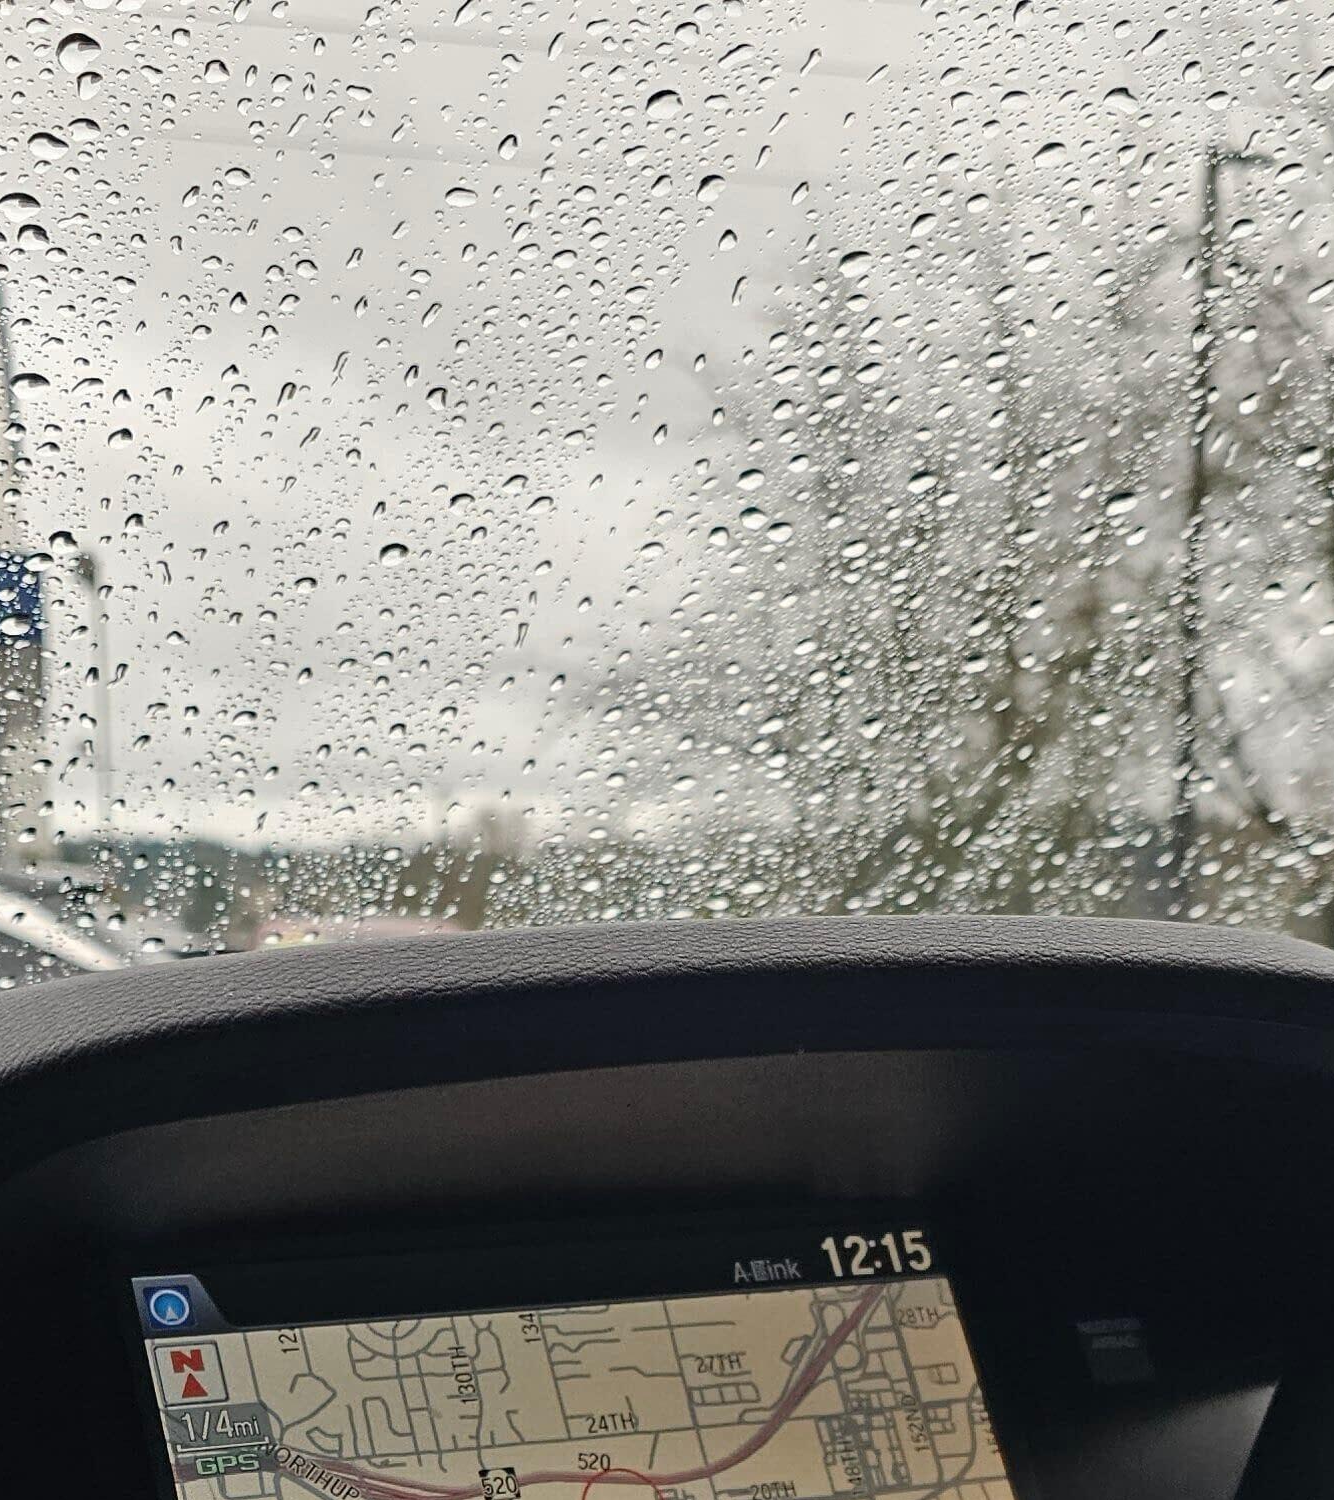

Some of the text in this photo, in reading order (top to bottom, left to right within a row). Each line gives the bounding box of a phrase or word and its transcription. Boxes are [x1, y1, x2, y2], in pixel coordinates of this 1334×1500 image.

[821, 1230, 931, 1277] 12:15
[277, 1327, 301, 1354] 12
[519, 1313, 541, 1344] 134
[170, 1348, 205, 1373] N
[448, 1345, 477, 1405] 130TH
[585, 1412, 636, 1435] 24TH
[195, 1453, 261, 1475] GPS
[578, 1453, 611, 1472] 520
[481, 1475, 518, 1497] 520
